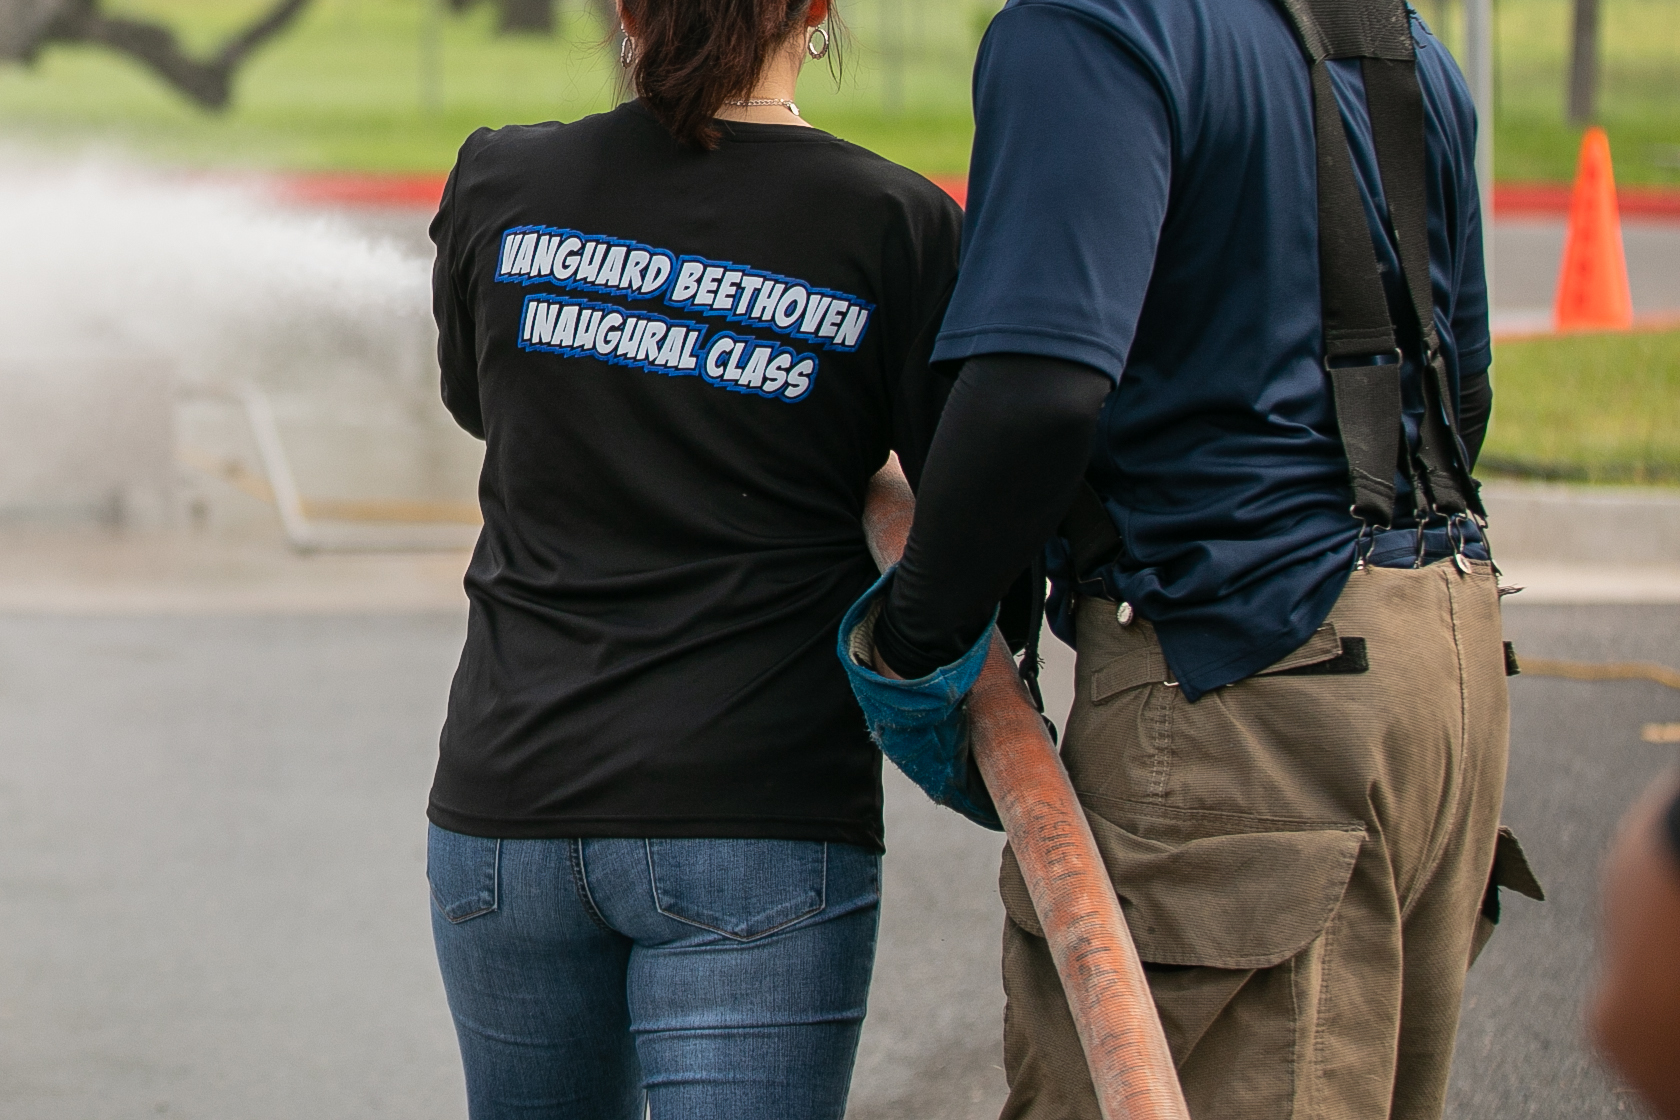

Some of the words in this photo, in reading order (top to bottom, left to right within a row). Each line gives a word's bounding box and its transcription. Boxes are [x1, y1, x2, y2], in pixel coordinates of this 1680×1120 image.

[499, 231, 672, 295] VANGUARD
[670, 260, 870, 348] BEETHOVEN
[522, 300, 709, 370] INAUGURAL
[704, 336, 816, 399] CLASS
